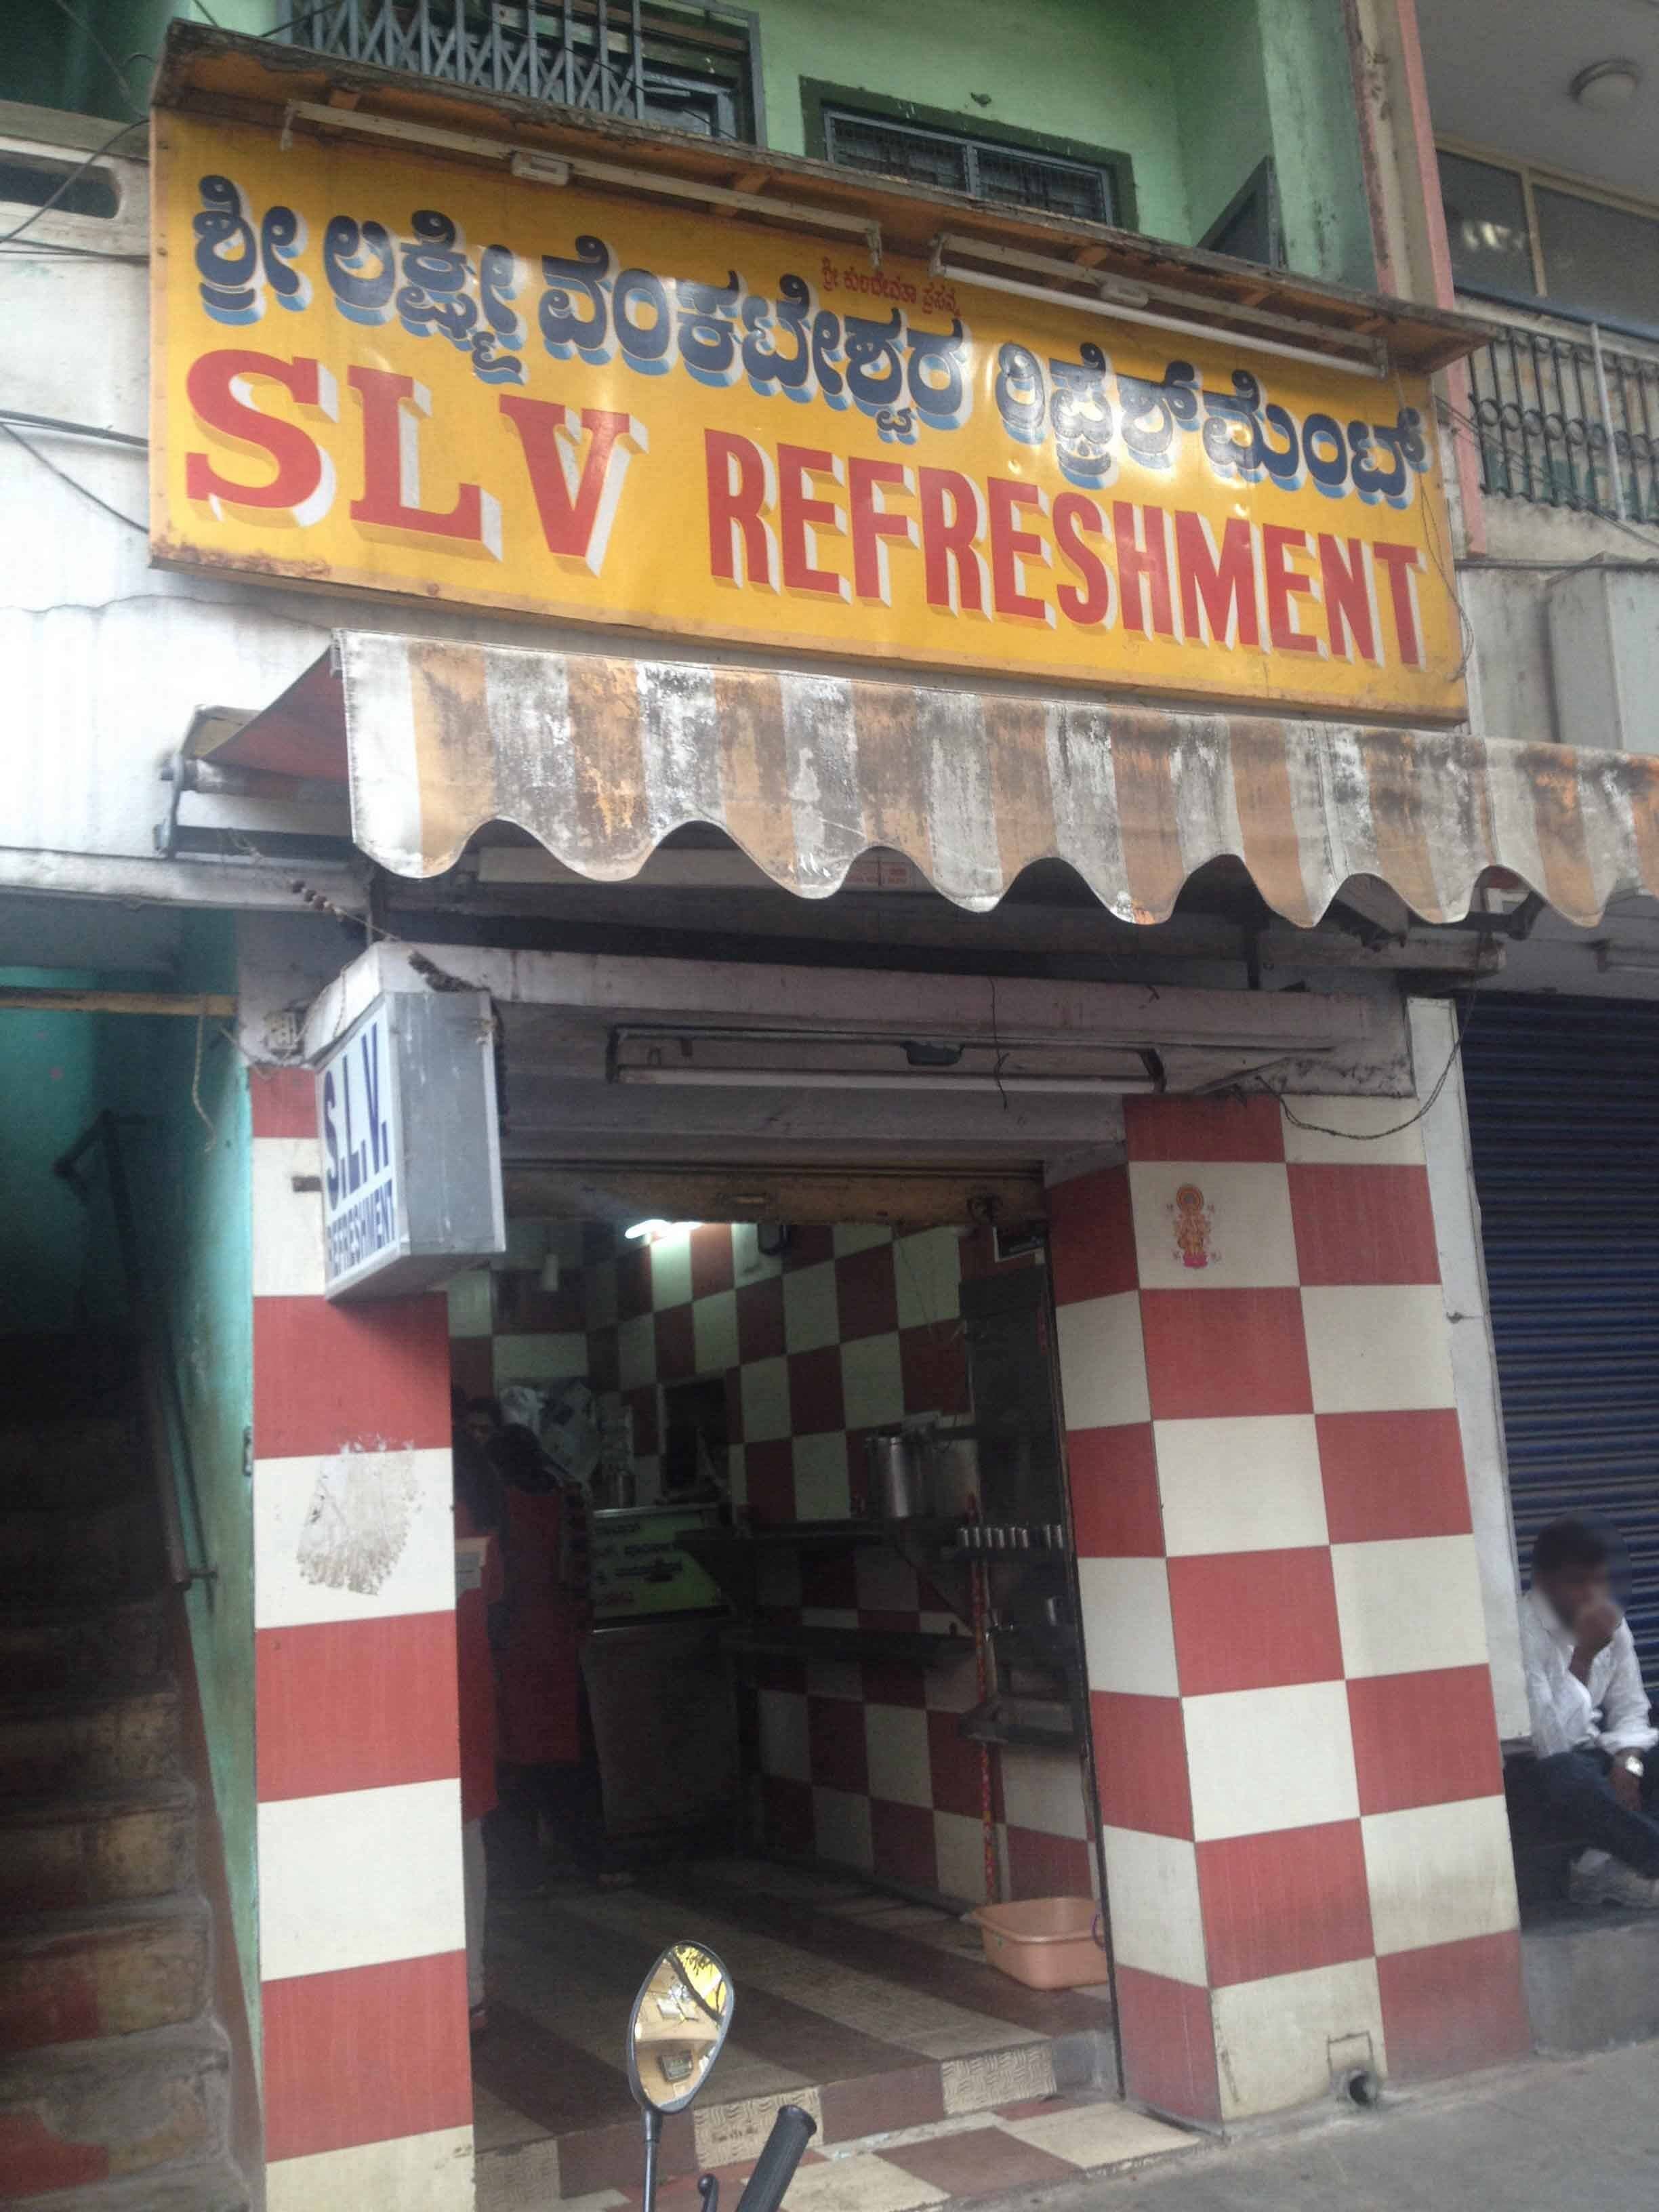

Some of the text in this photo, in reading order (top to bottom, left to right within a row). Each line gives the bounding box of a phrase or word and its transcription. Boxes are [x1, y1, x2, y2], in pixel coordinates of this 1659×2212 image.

[192, 174, 310, 324] ಶ್ರೀ
[539, 234, 972, 445] ವೆಂಕಟೇಶ್ವರ
[185, 348, 1427, 672] SLV REFRESHMENT
